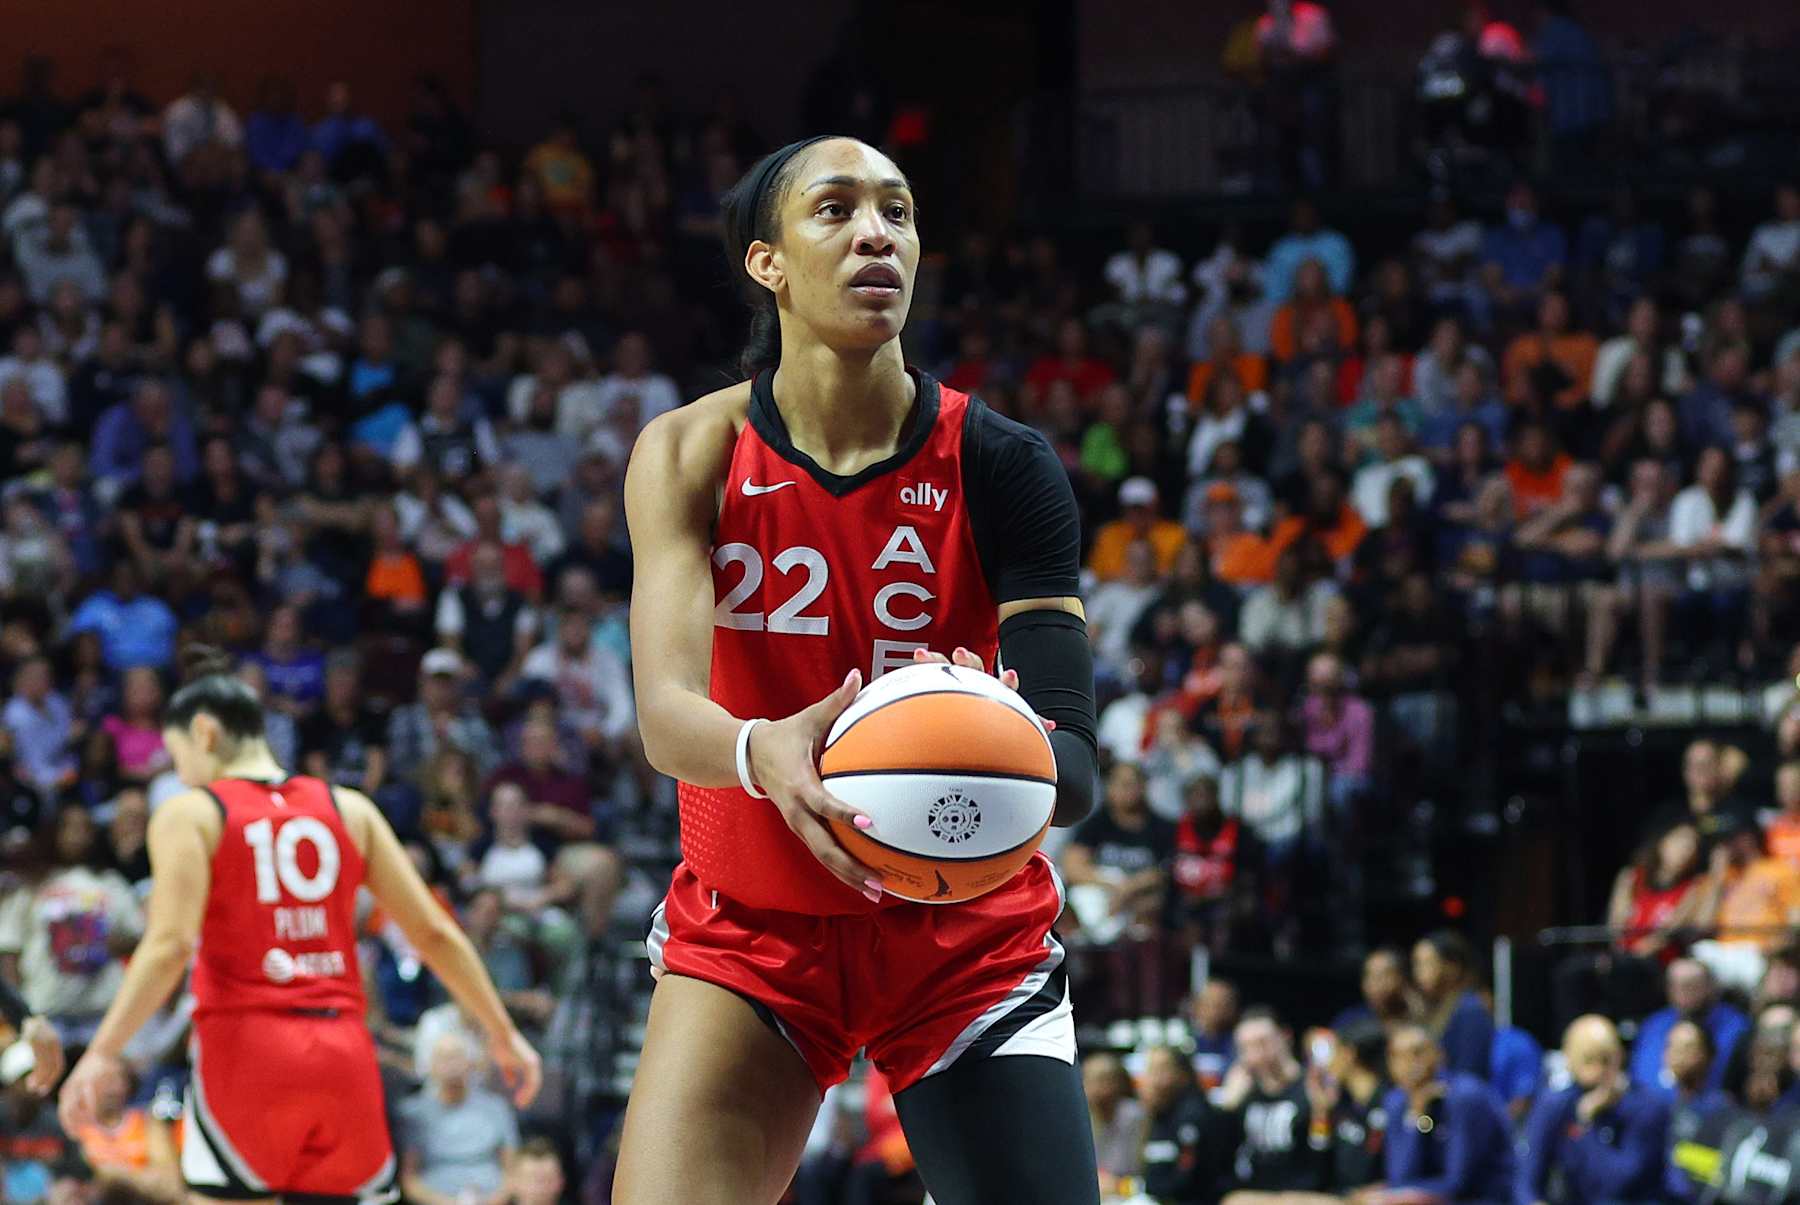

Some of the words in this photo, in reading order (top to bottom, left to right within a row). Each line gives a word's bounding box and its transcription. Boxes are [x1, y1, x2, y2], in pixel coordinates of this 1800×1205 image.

[899, 482, 949, 512] ally
[711, 542, 830, 636] 22
[243, 816, 341, 904] 10
